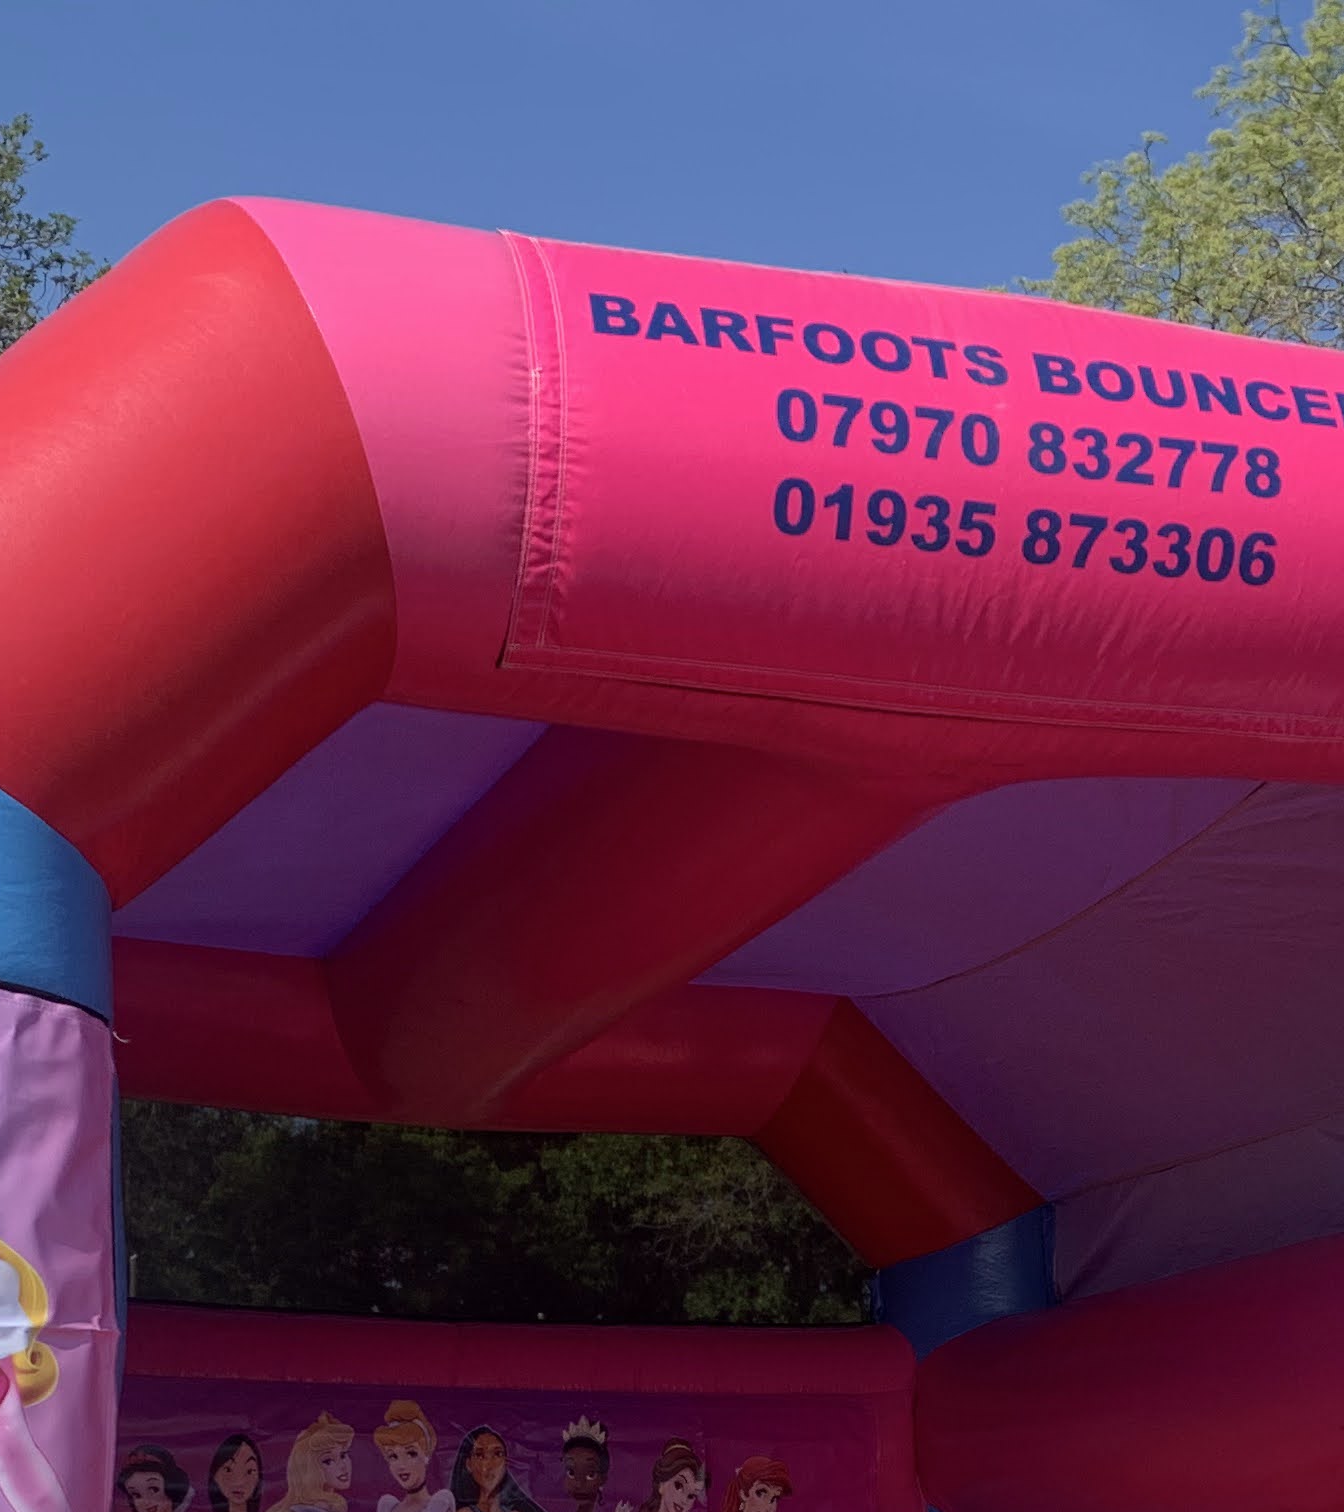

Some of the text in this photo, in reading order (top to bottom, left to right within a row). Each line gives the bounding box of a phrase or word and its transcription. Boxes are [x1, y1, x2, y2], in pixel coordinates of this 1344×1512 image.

[588, 293, 1009, 387] BARFOOTS
[776, 388, 1282, 499] 07970 832778
[773, 477, 1276, 586] 01935 873306
